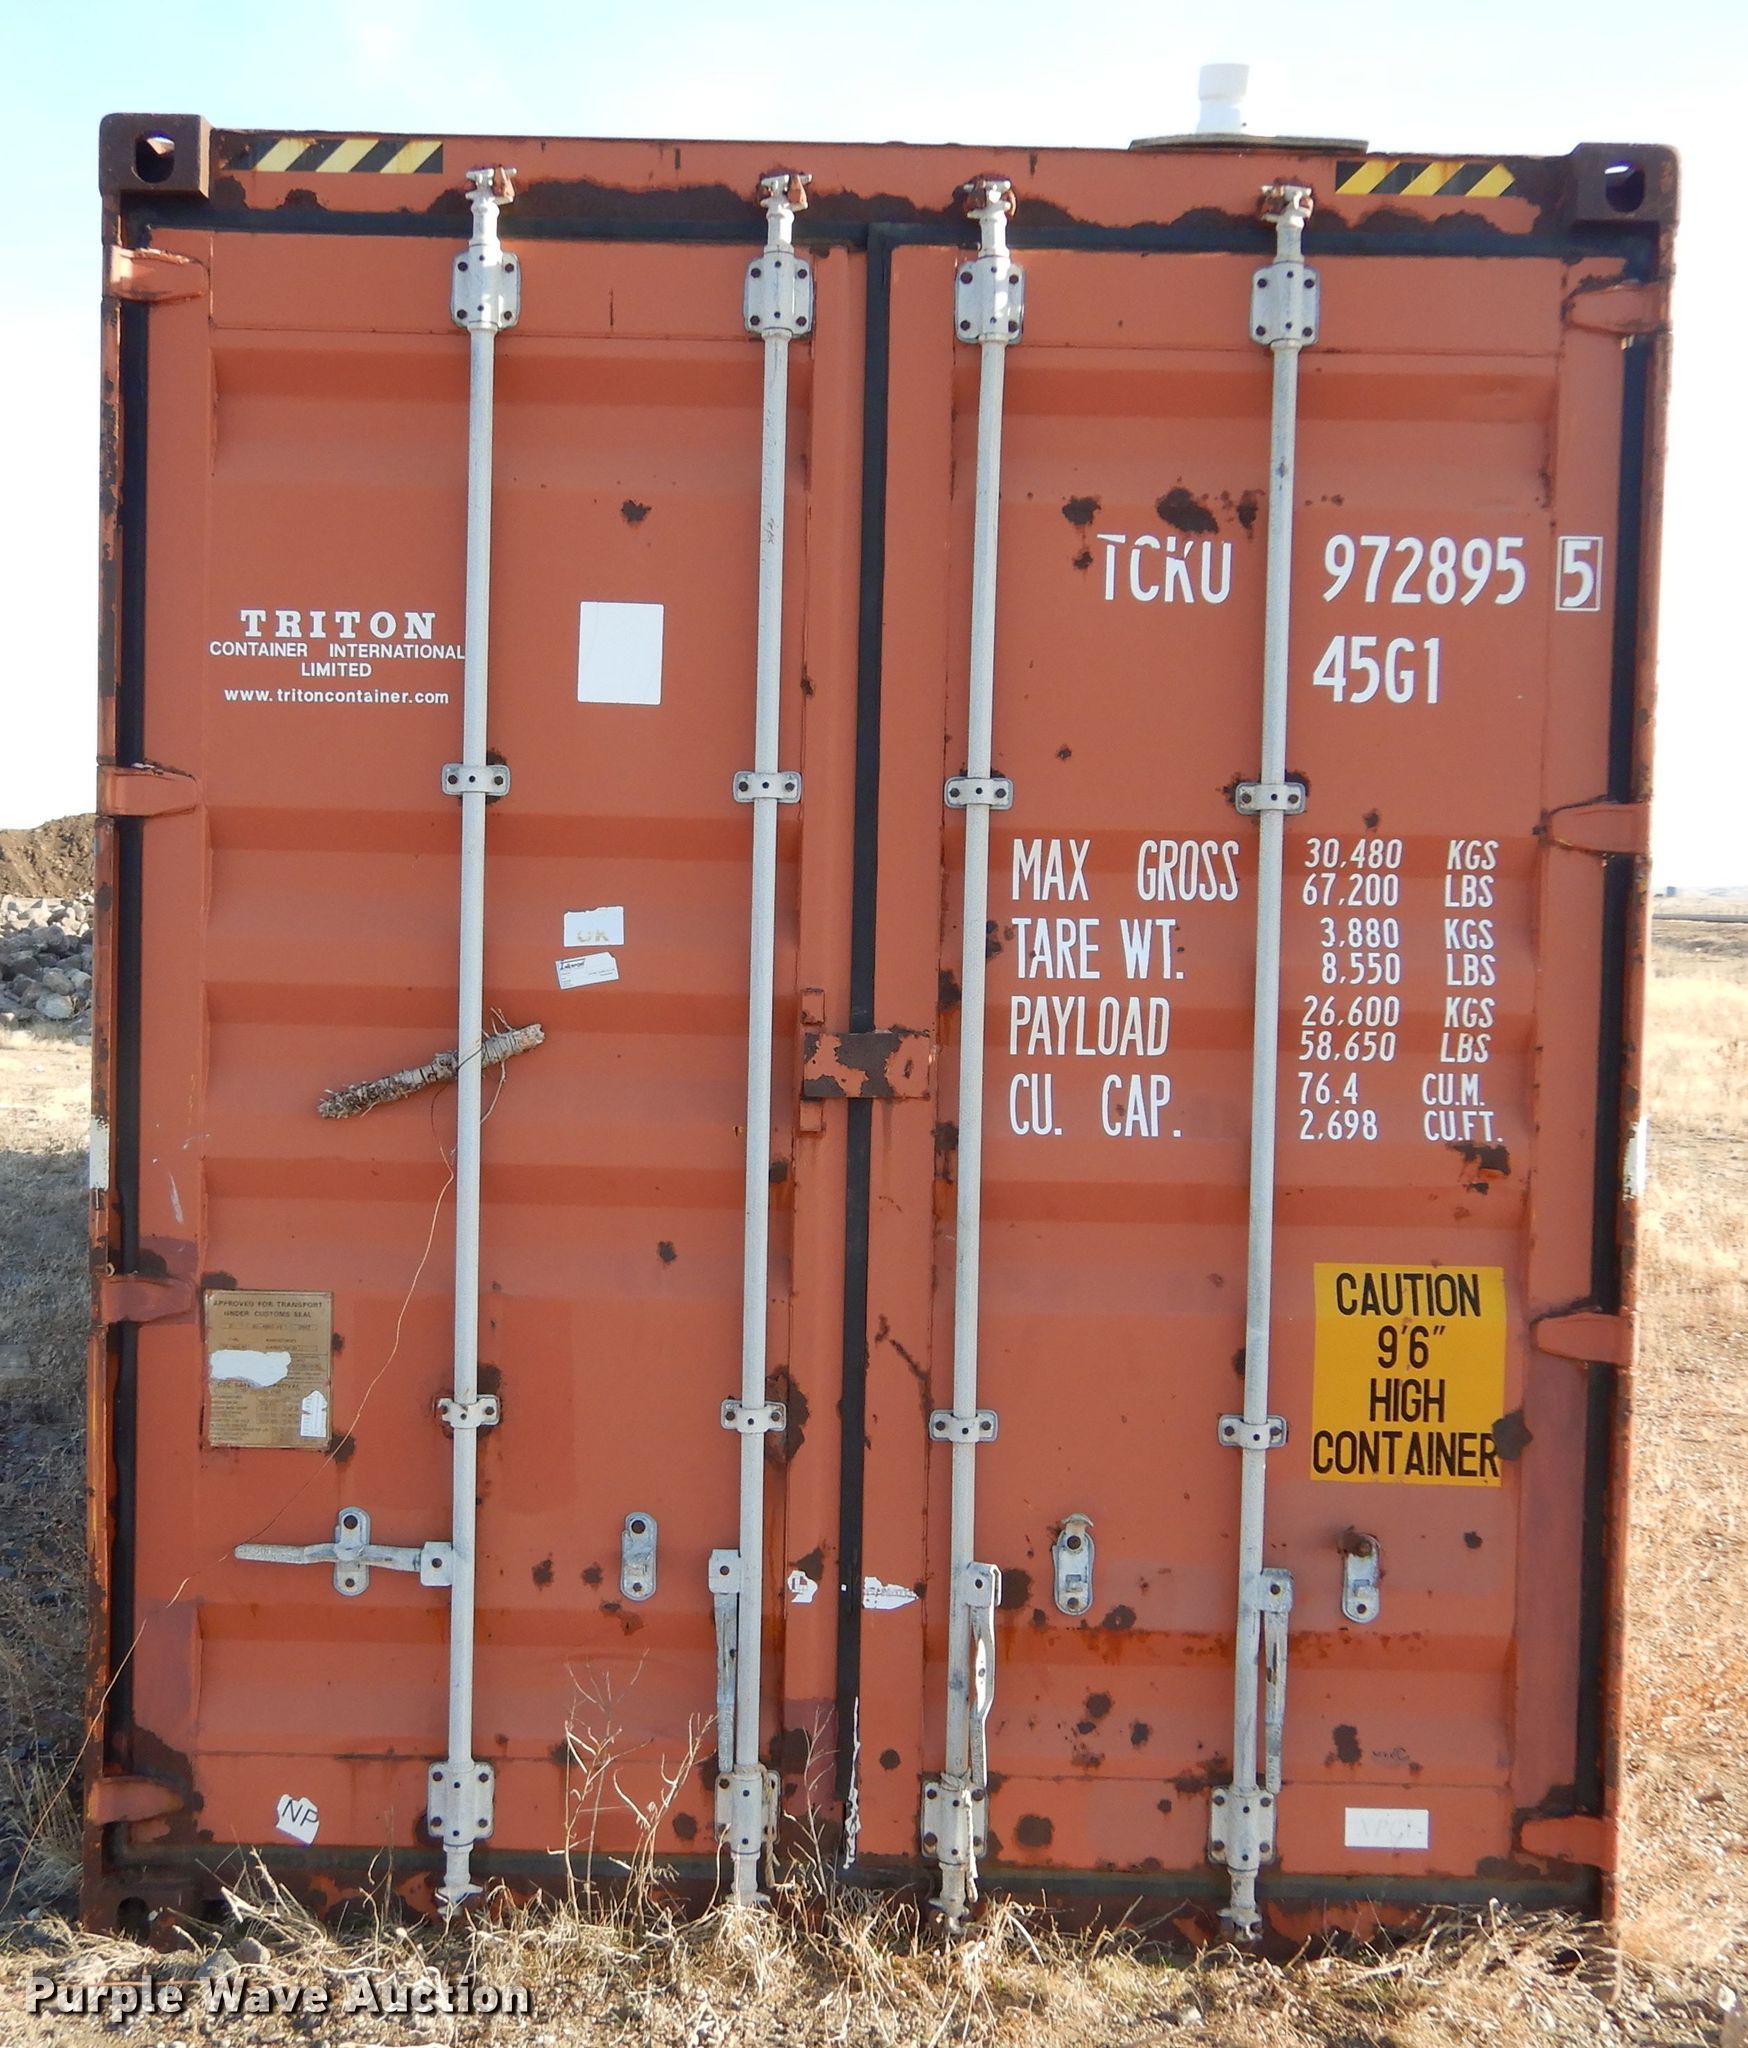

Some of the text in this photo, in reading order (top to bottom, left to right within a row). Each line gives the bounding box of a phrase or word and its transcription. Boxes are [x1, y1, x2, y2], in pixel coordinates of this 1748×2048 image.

[1097, 533, 1595, 607] TCKU 972895 5
[240, 609, 436, 639] TRITON
[209, 641, 466, 660] CONTAINER INTERNATIONAL
[301, 662, 372, 677] LIMITED
[1312, 635, 1440, 703] 45G1
[1012, 838, 1499, 901] MAX GROSS 30,480 KGS
[1302, 872, 1494, 908] 67,200 LBS
[1011, 917, 1495, 980] TARE WT. 3,880 KGS
[1321, 951, 1496, 986] 8,550 LBS
[1009, 995, 1496, 1056] PAYLOAD 26,600 KGS
[1298, 1030, 1492, 1063] 58,650 LBS
[1009, 1072, 1486, 1138] CU. CAP. 76.4 CU.M.
[1299, 1109, 1504, 1142] 2,698 CU.FT.
[277, 1301, 323, 1309] TRANSPORT
[1336, 1272, 1482, 1317] CAUTION
[1369, 1378, 1446, 1423] HIGH
[1312, 1430, 1500, 1478] CONTAINER
